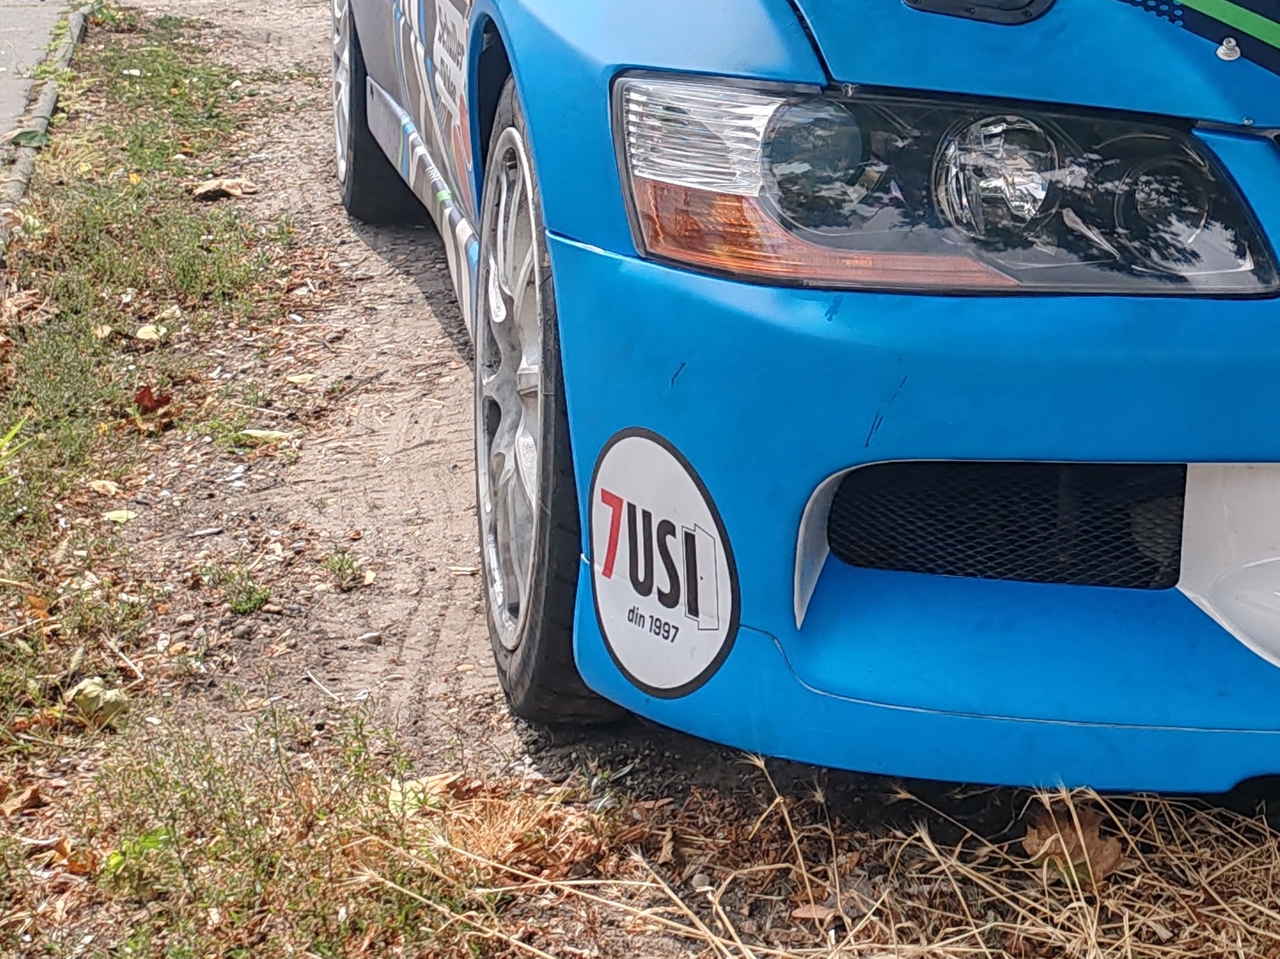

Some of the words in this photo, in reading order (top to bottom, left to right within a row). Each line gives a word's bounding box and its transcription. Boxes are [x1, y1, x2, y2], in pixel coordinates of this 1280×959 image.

[600, 487, 700, 620] 7USI
[626, 606, 646, 631] din
[648, 615, 680, 643] 1997
